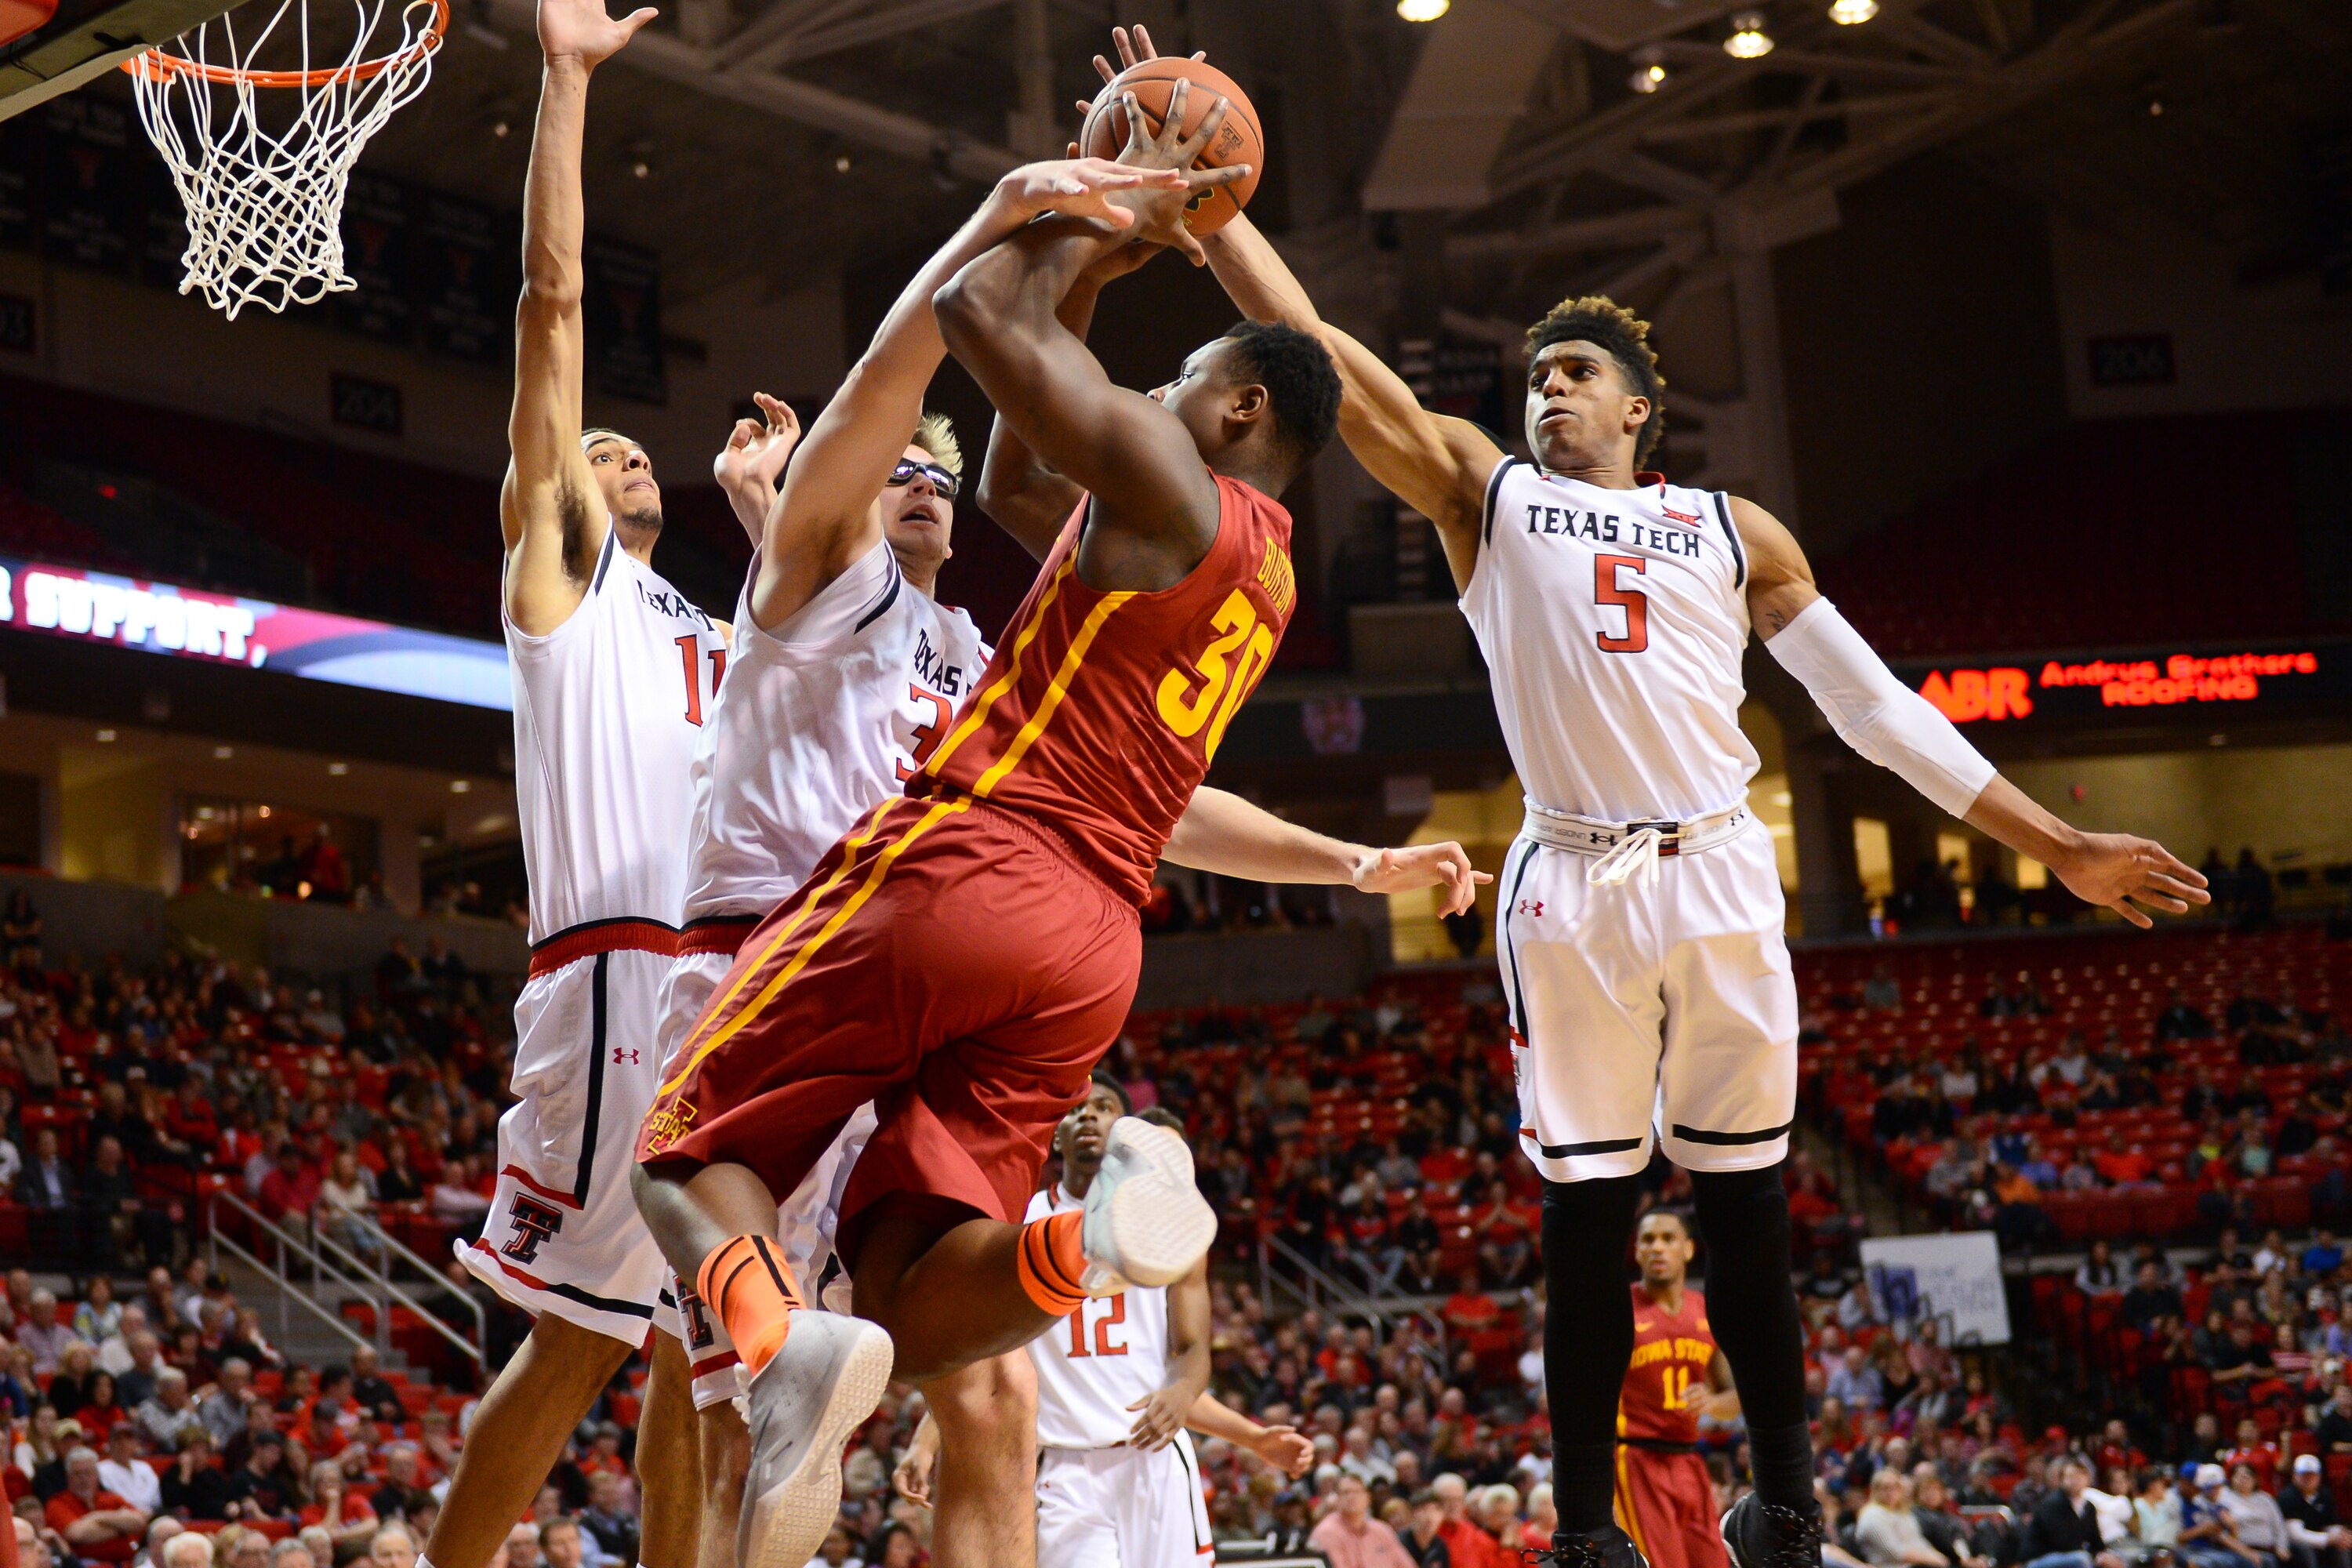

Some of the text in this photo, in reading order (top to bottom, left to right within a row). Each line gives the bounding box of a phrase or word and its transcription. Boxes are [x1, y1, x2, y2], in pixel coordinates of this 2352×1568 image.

[1527, 504, 1700, 557] TEXAS TECH
[1257, 535, 1295, 615] BURTON
[1594, 554, 1649, 654] 5
[913, 627, 963, 697] TEXAS
[1156, 588, 1274, 768] 30
[2102, 673, 2258, 706] ROOFING
[1918, 667, 2033, 722] ABR
[649, 1111, 692, 1145] STAT
[1067, 1293, 1128, 1358] 12
[1663, 1366, 1690, 1410] 11
